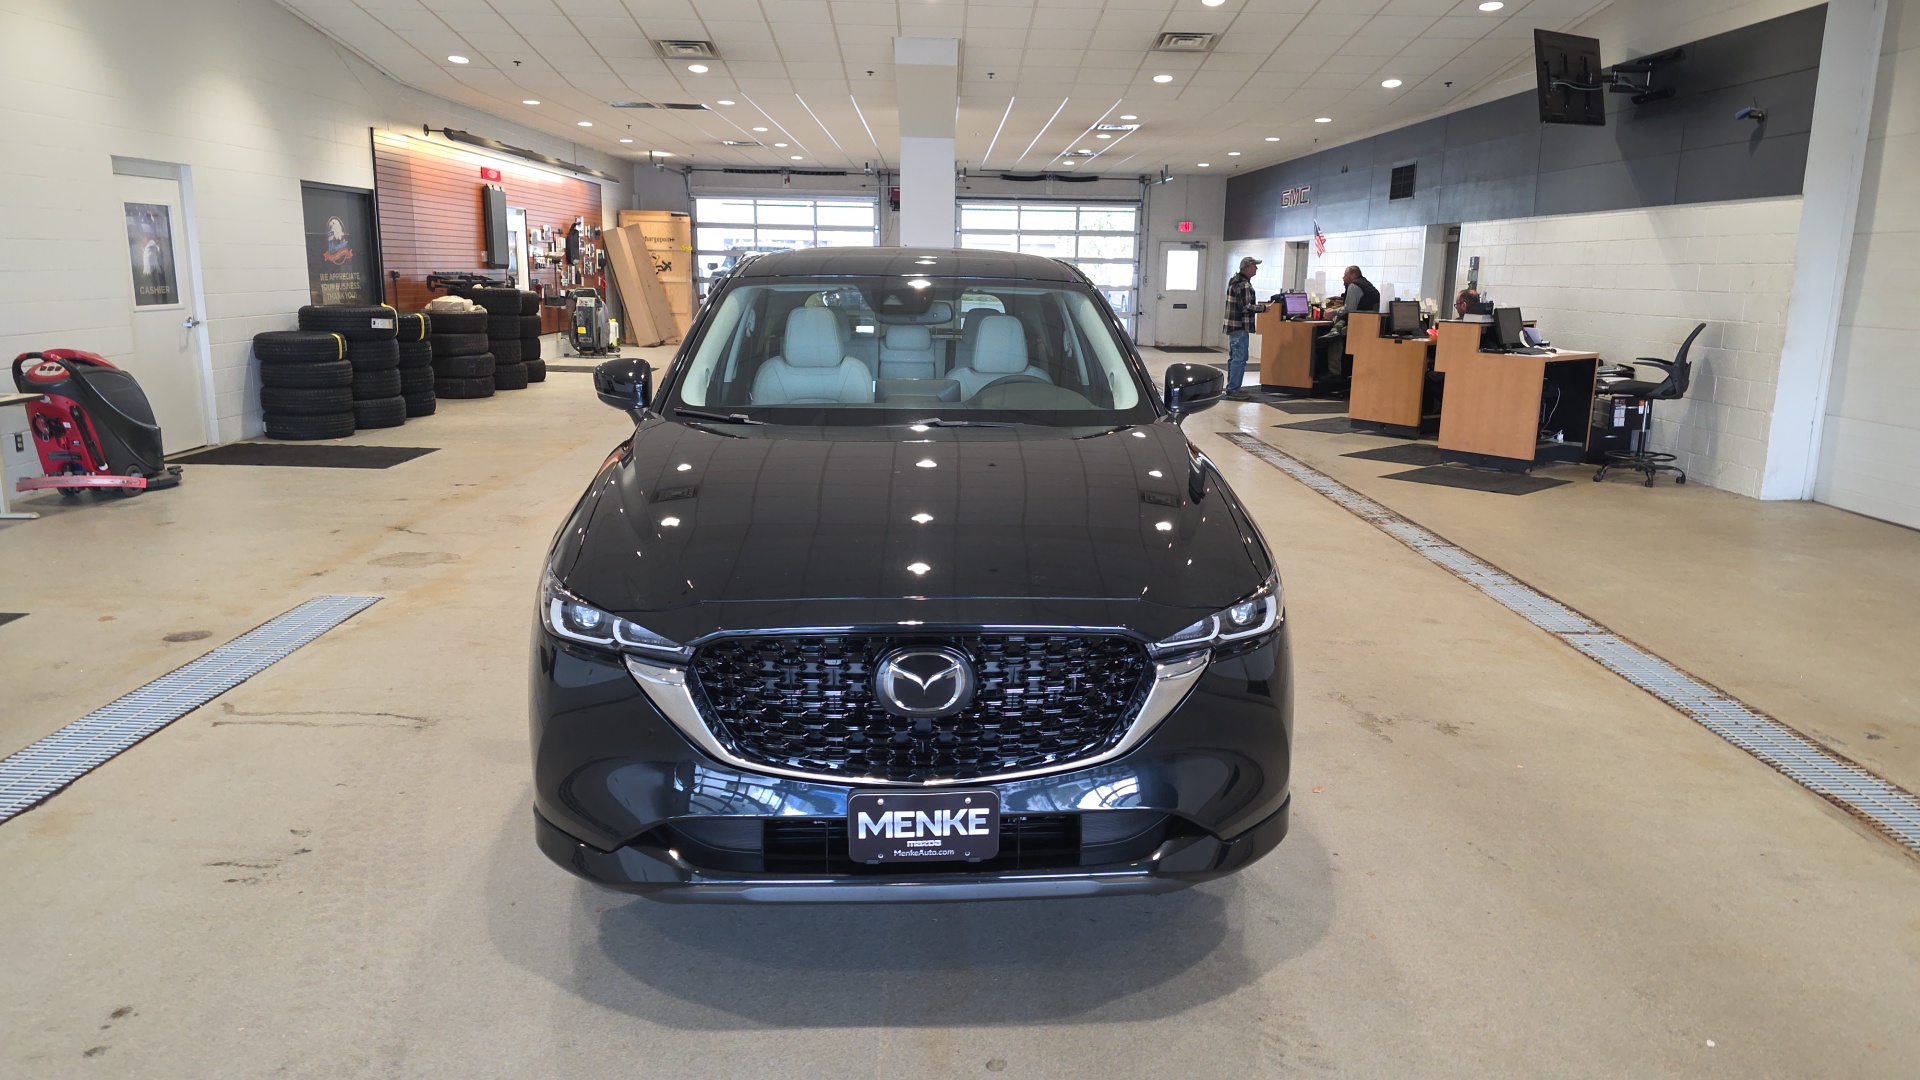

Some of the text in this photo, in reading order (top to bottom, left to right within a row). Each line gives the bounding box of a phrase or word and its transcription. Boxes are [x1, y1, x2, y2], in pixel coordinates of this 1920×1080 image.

[1281, 185, 1311, 208] GMC
[320, 272, 360, 281] WE APPRECIATE
[140, 286, 170, 295] CASHIER
[320, 283, 335, 291] YOUR
[327, 292, 344, 300] THANK
[857, 808, 990, 839] MENKE
[893, 849, 955, 857] MenkeAuto.com
